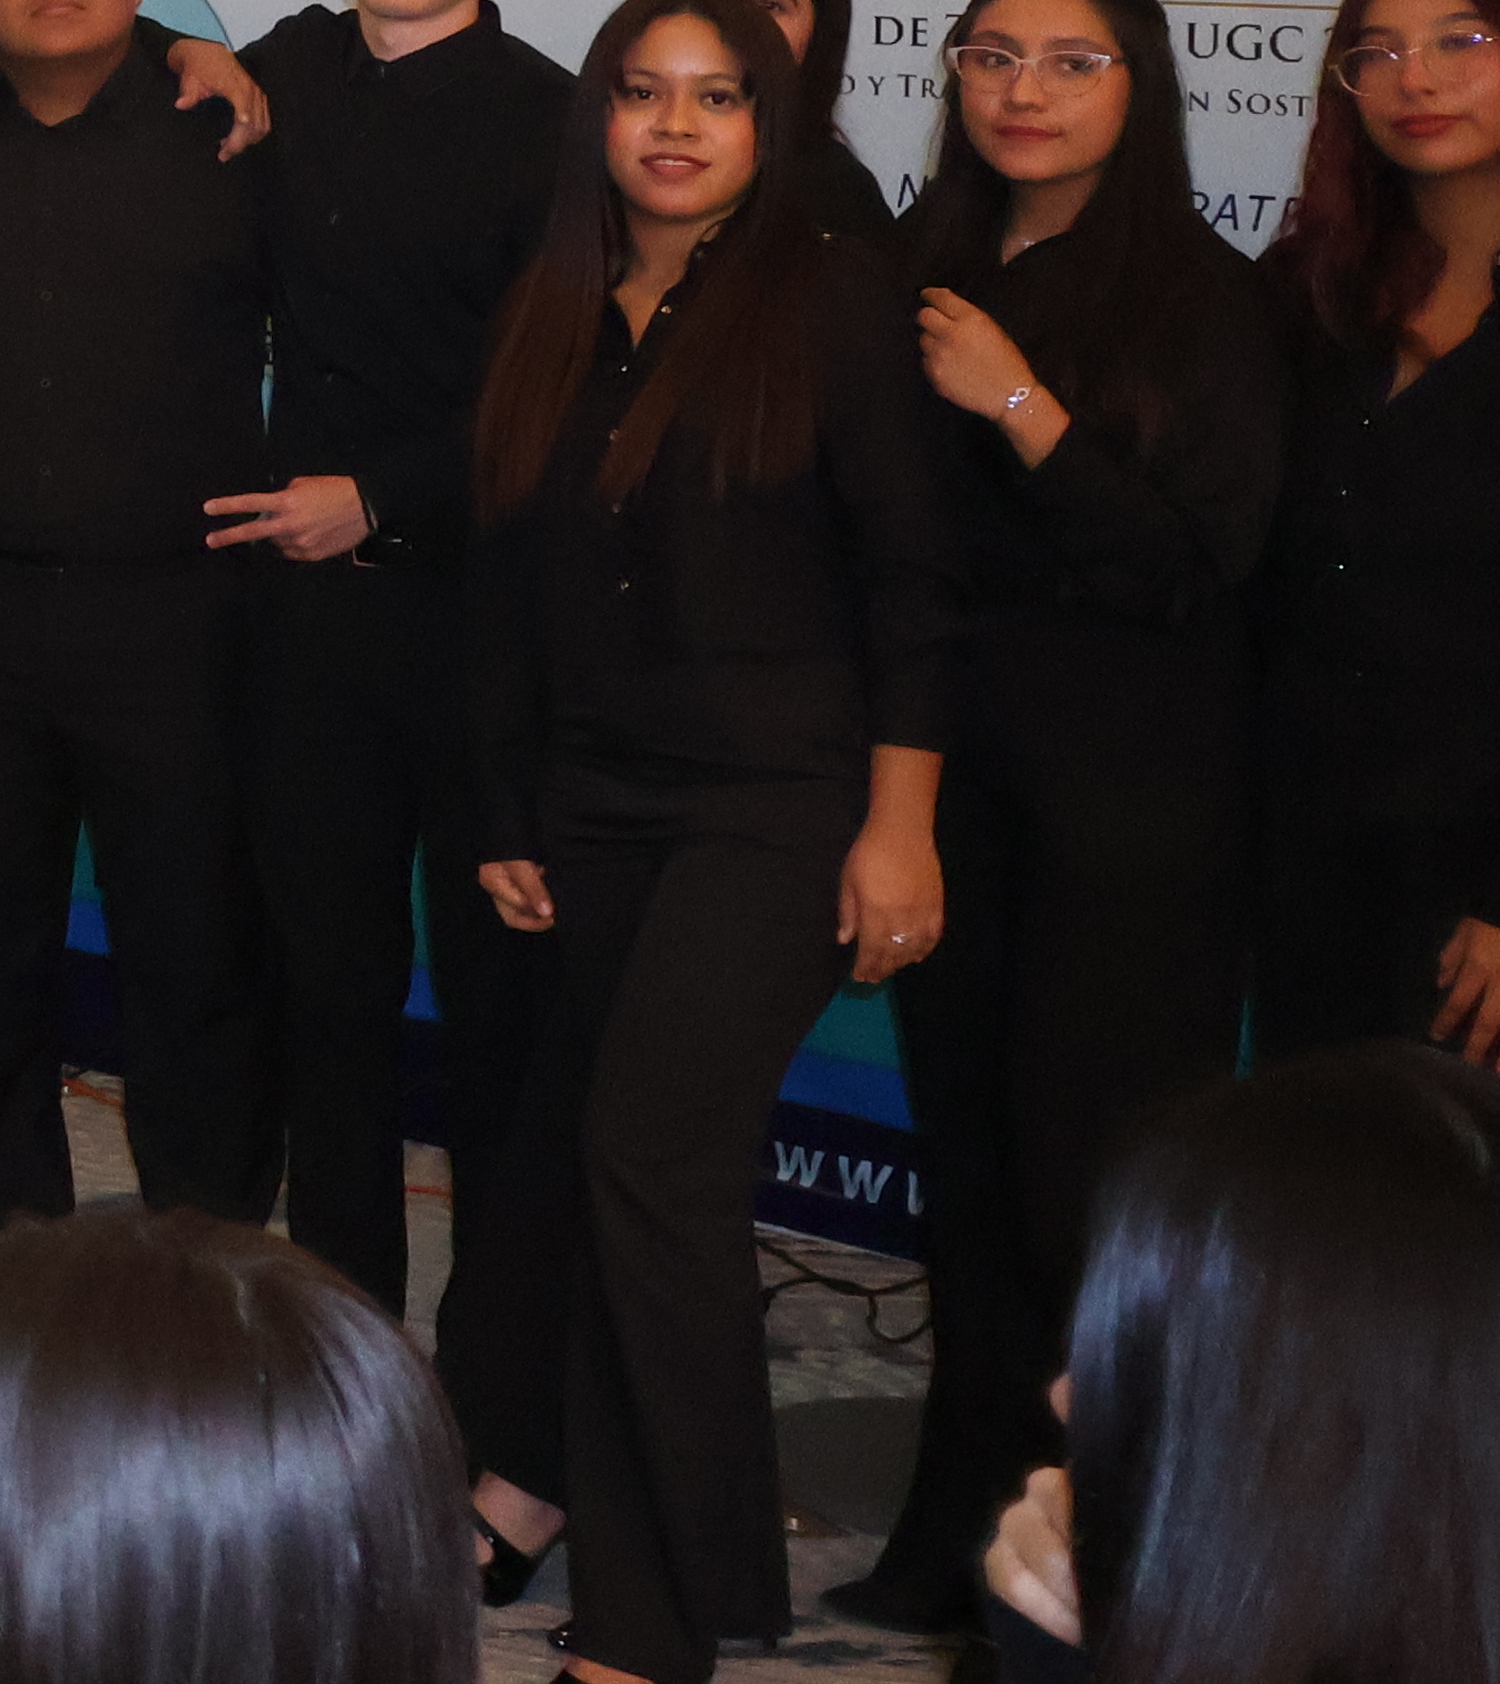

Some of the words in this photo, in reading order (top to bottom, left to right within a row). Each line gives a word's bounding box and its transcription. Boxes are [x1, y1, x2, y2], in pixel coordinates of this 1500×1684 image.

[874, 15, 928, 47] DE
[1187, 22, 1303, 63] UGC
[868, 76, 885, 96] Y
